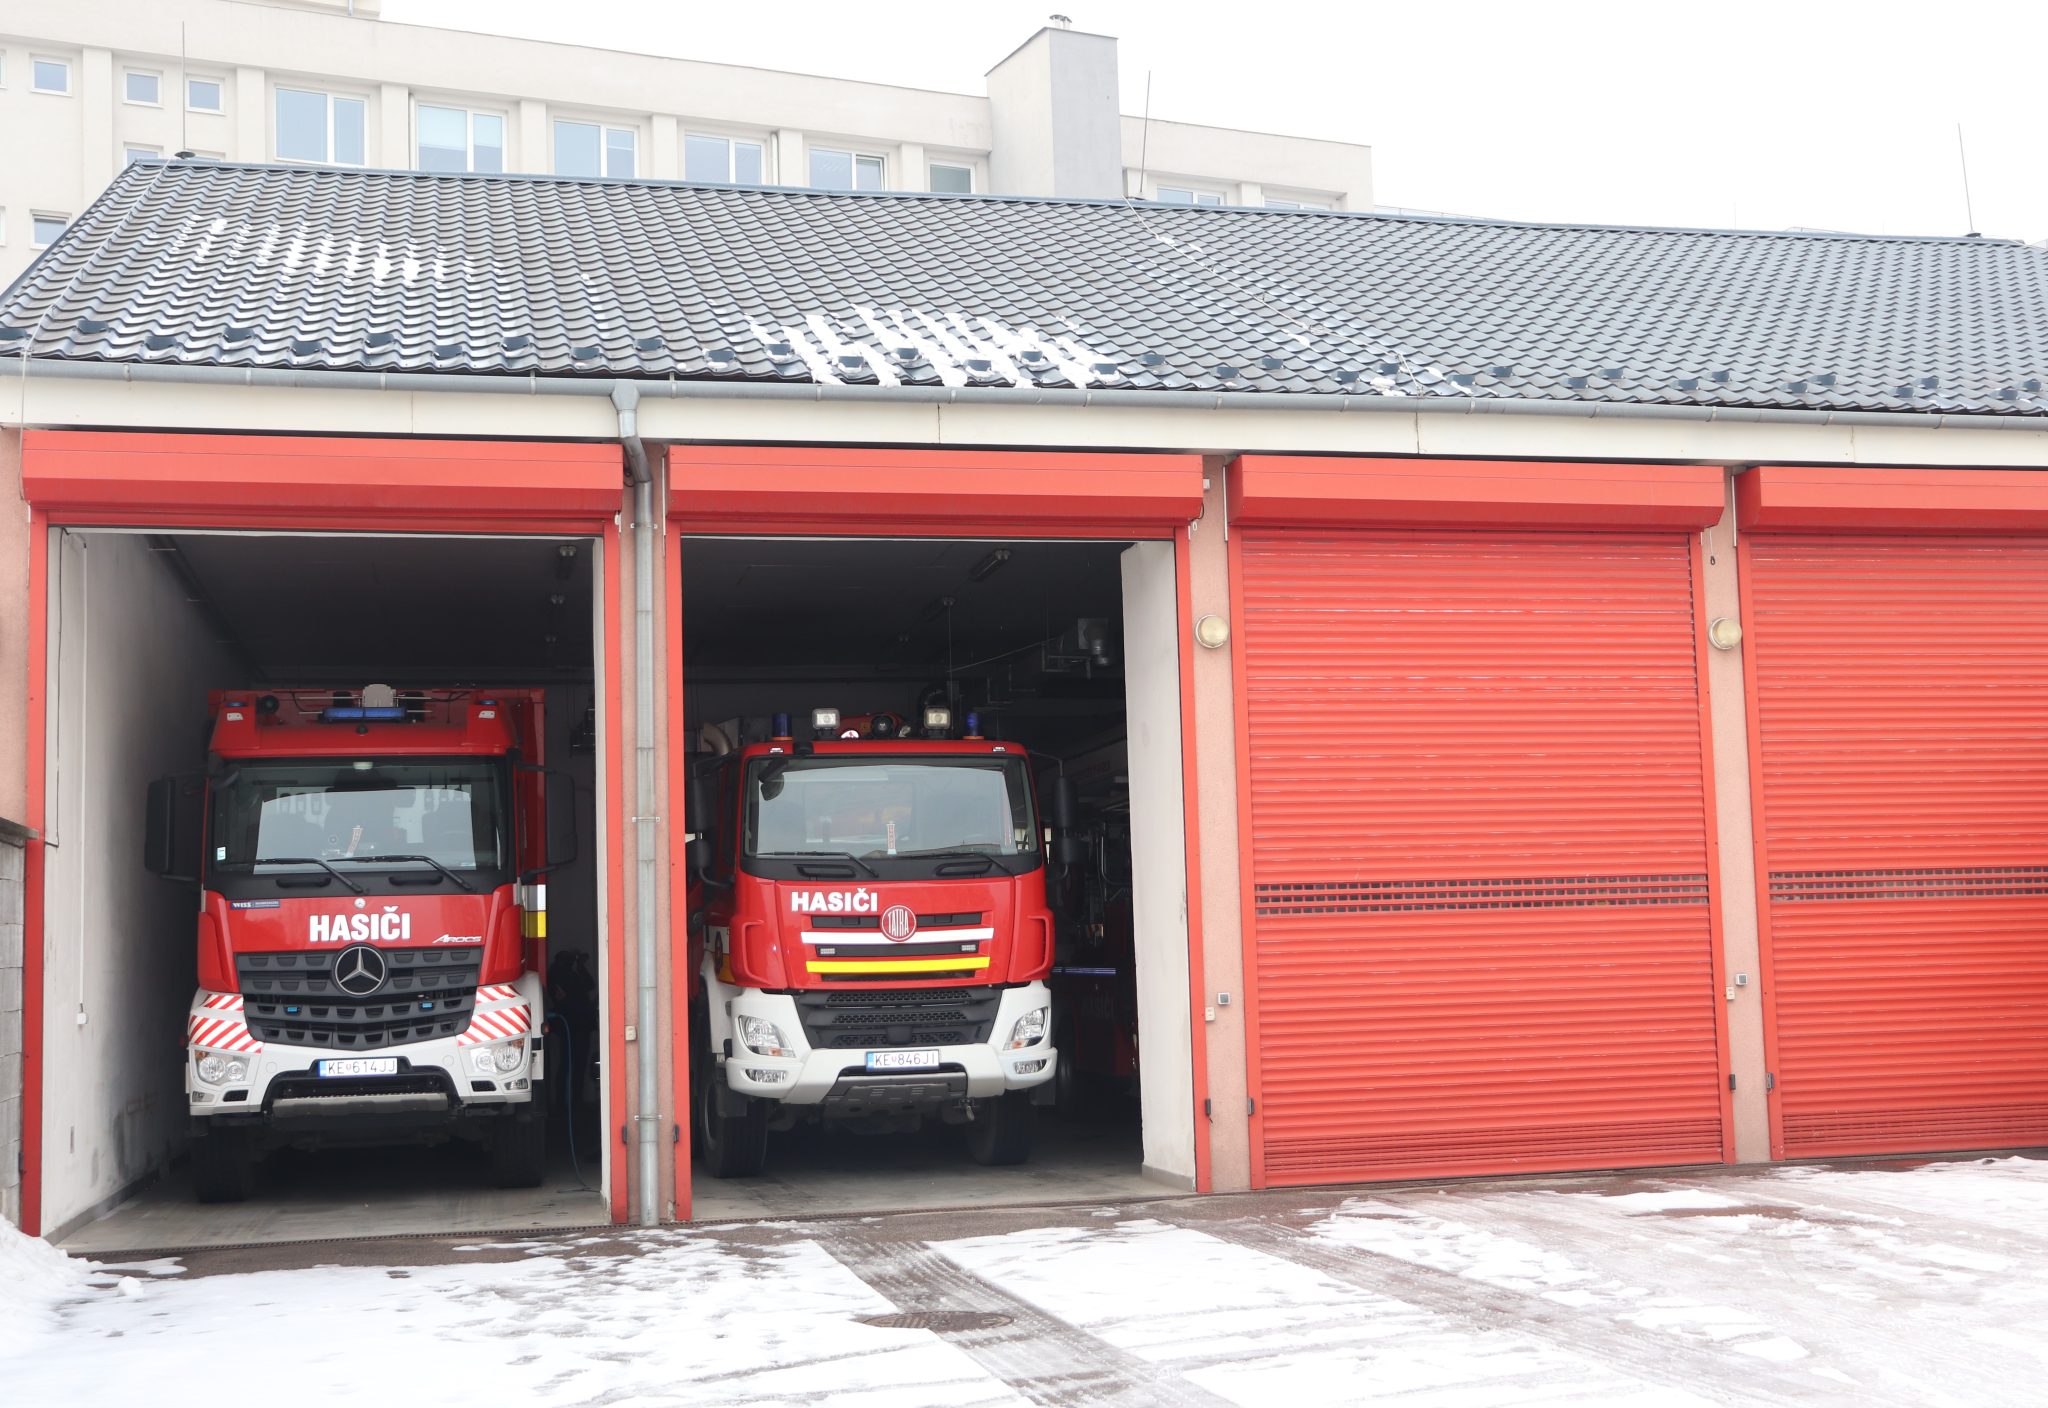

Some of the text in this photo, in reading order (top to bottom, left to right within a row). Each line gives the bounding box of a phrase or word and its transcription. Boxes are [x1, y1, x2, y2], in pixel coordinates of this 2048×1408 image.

[791, 887, 878, 912] HASIČI
[309, 905, 411, 942] HASIČI
[887, 909, 909, 938] TATRA
